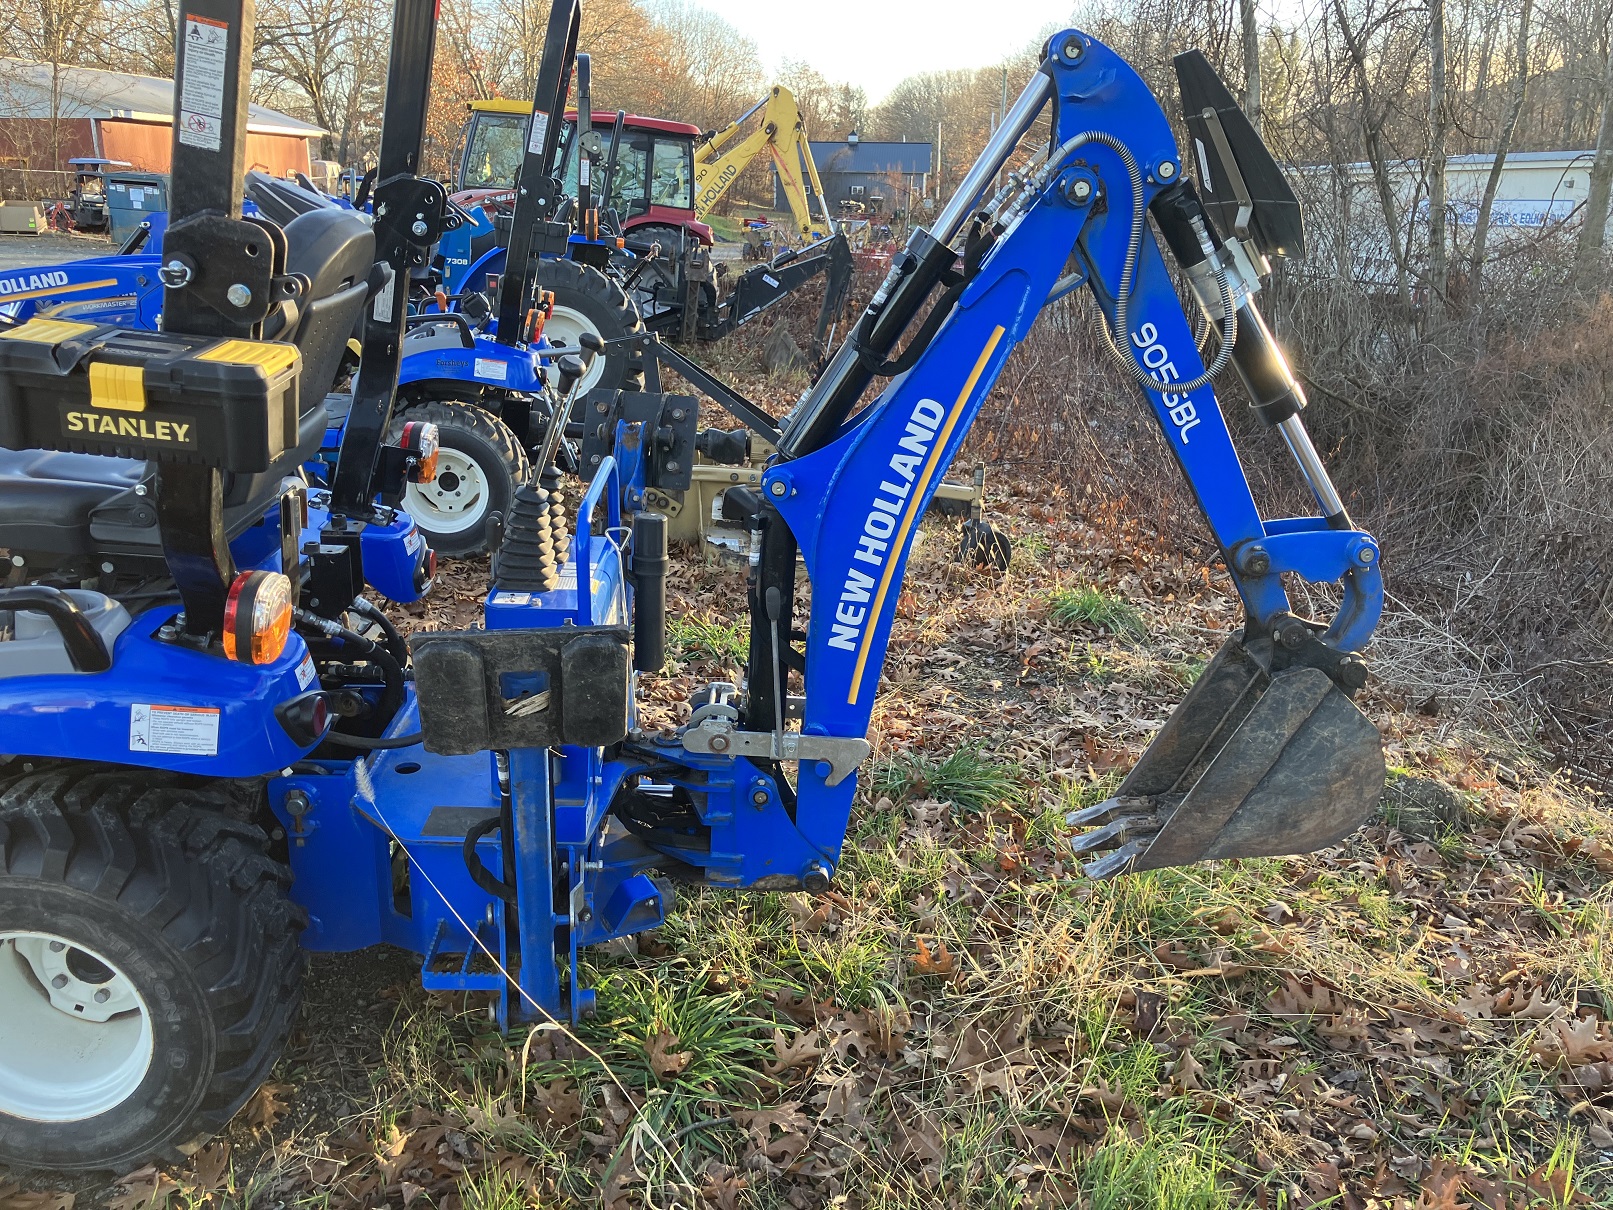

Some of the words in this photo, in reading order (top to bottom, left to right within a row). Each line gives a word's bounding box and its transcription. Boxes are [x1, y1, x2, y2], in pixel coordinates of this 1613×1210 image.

[701, 165, 737, 206] HOLLAND
[82, 301, 127, 310] WORKMASTER
[67, 411, 190, 442] STANLEY
[828, 567, 876, 652] NEW
[854, 398, 945, 567] HOLLAND
